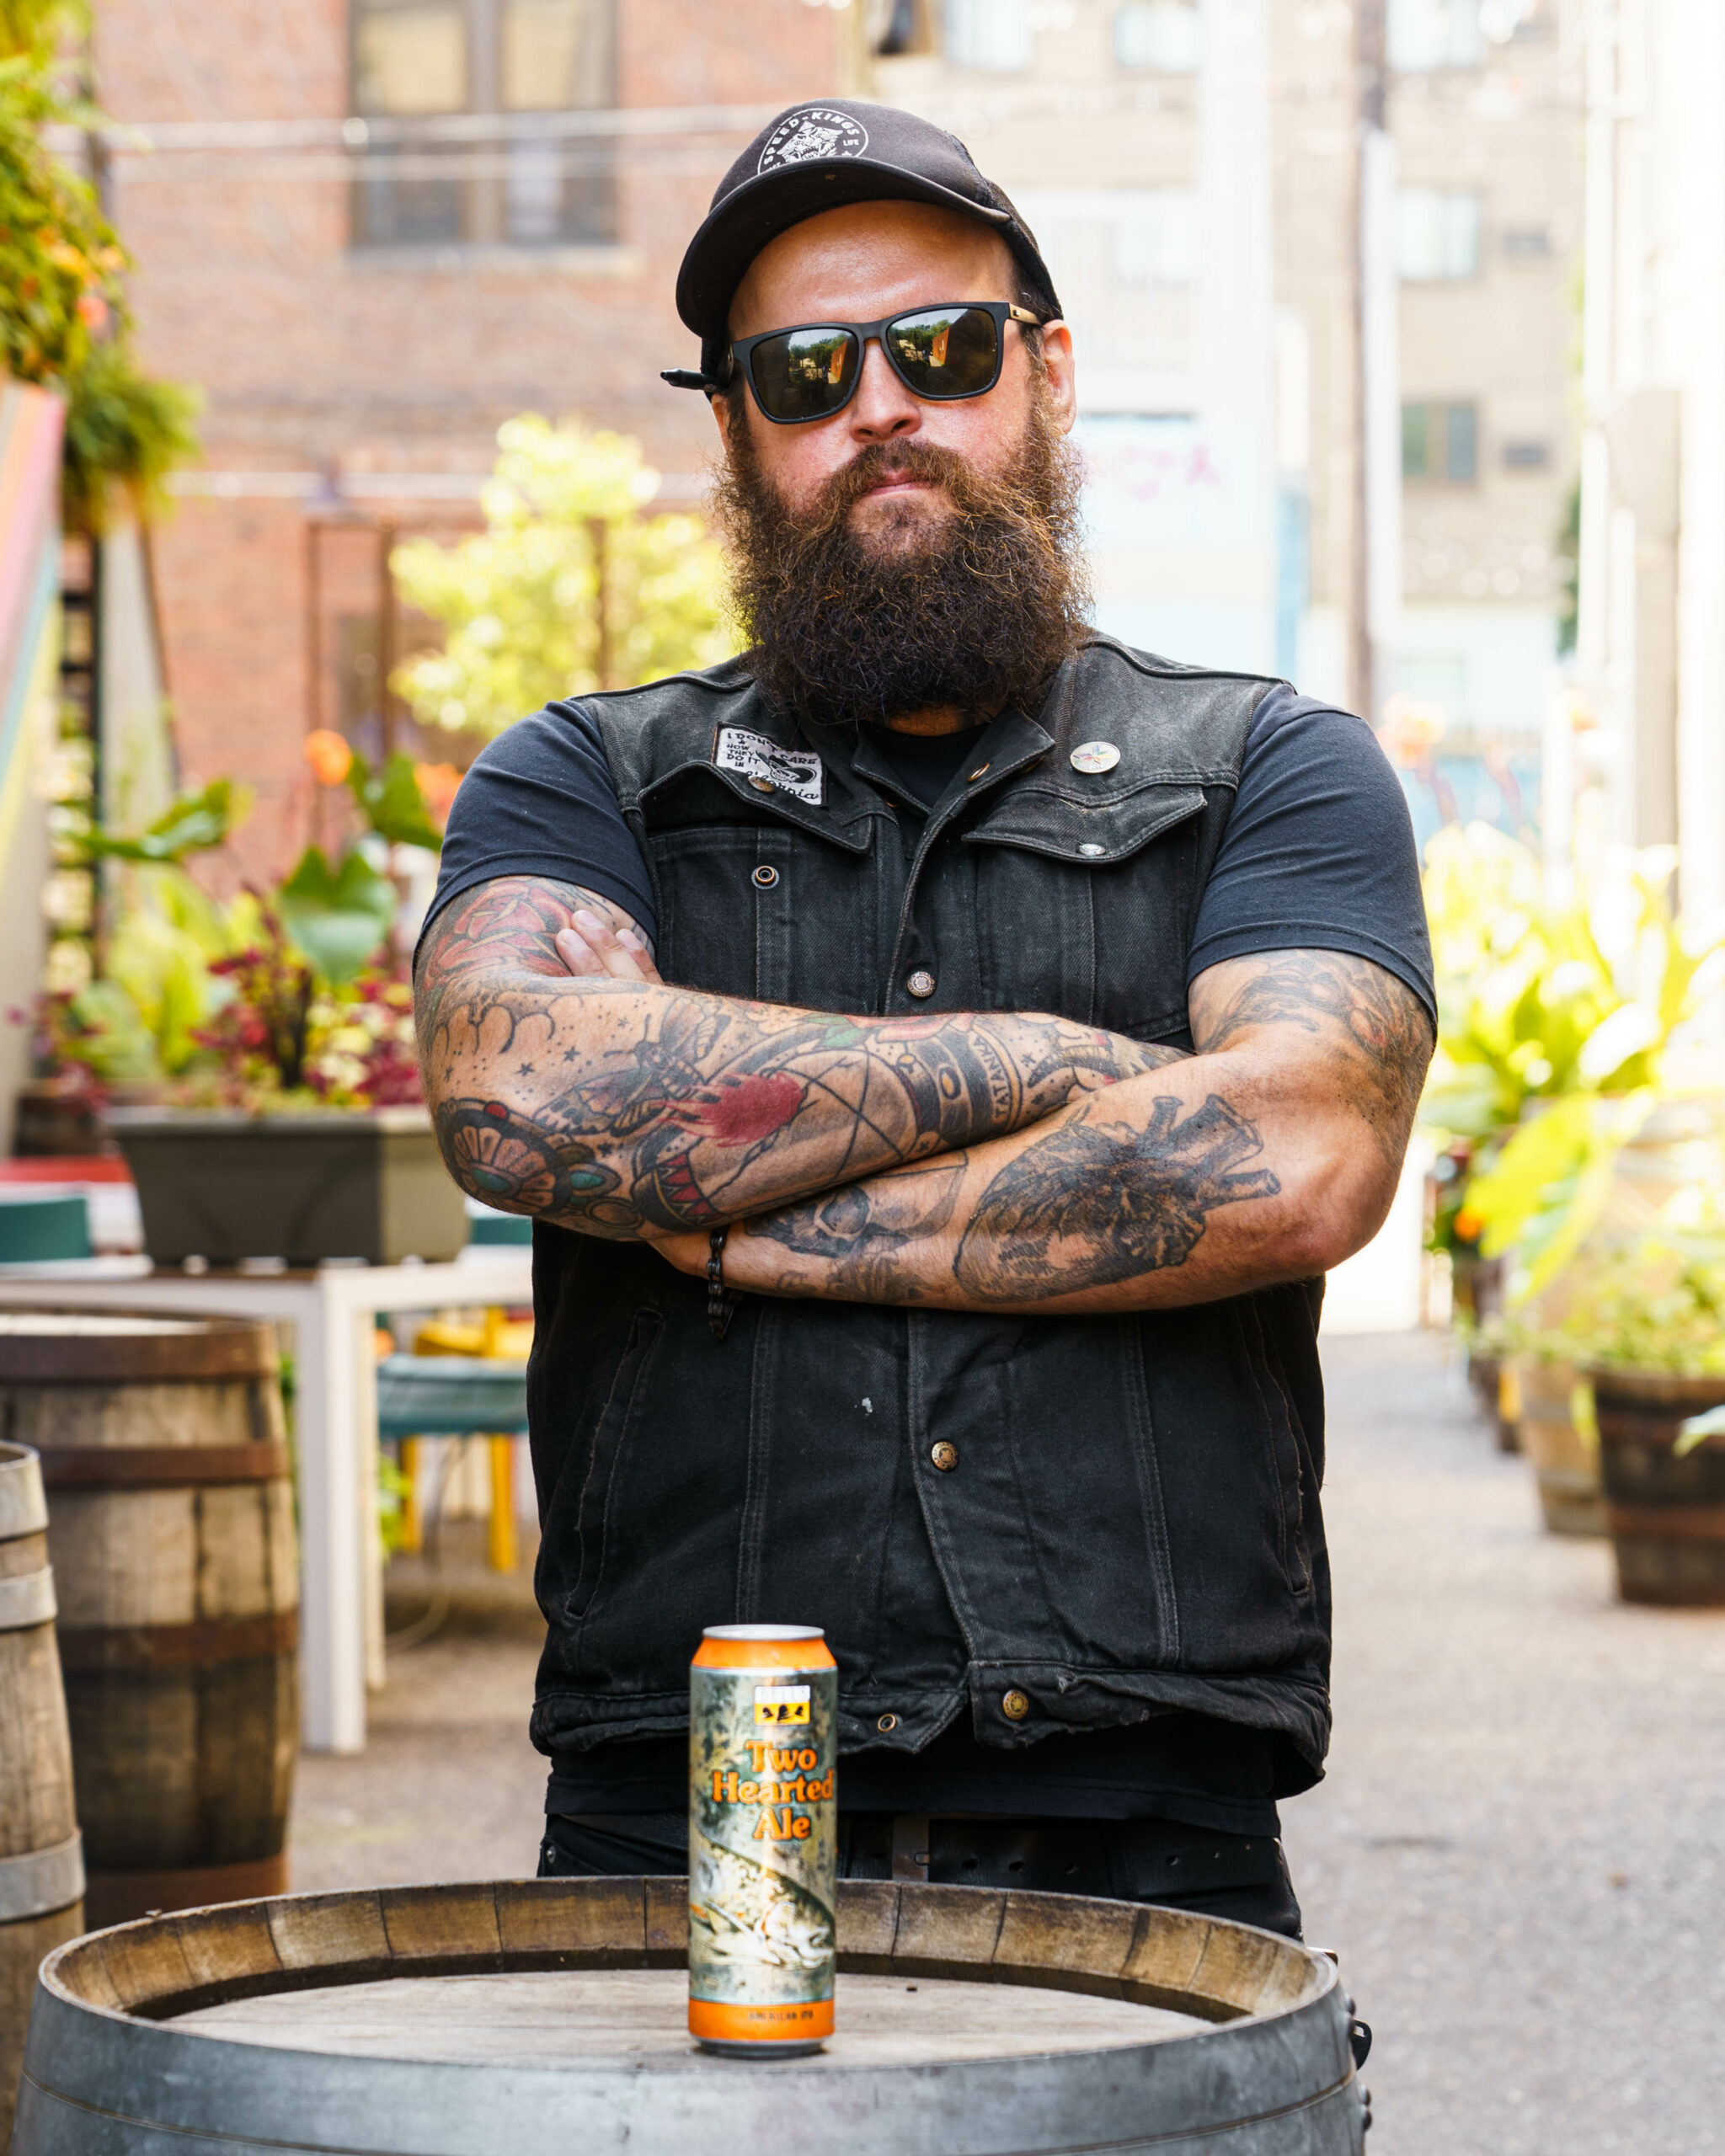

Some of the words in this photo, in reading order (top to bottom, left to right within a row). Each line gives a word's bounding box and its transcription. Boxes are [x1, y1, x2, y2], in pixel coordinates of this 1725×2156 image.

[726, 743, 750, 751] HOW
[728, 749, 756, 757] THEY
[726, 753, 745, 761] DO
[747, 756, 761, 765] IT
[780, 754, 818, 765] CARE
[746, 1741, 817, 1772] Two
[712, 1770, 833, 1804] Hearted
[753, 1807, 810, 1839] Ale
